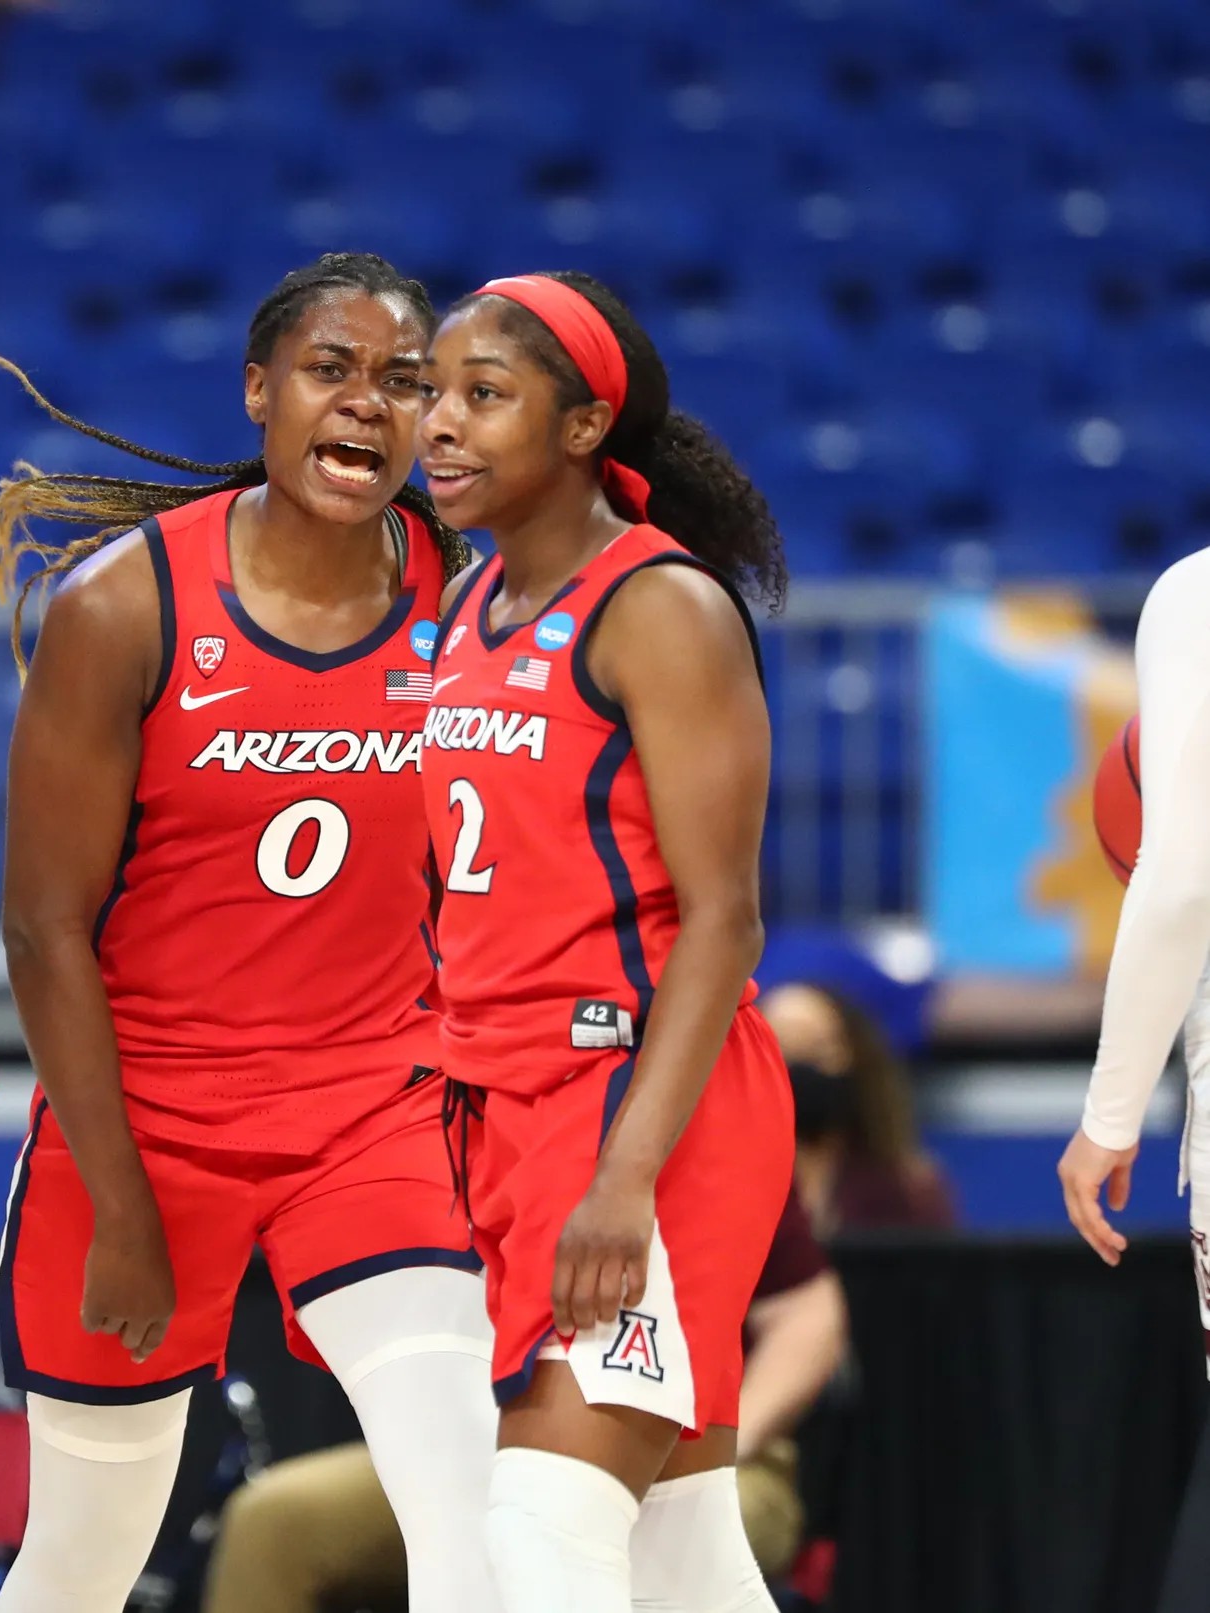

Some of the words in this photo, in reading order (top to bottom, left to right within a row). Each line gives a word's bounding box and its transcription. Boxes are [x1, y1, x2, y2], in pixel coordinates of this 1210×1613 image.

[193, 637, 226, 662] PAC
[198, 653, 216, 669] 12
[414, 637, 435, 650] NCA
[187, 729, 424, 774] ARIZONA
[421, 705, 548, 761] ARIZONA
[254, 796, 351, 899] 0
[445, 777, 498, 894] 2
[581, 1004, 608, 1023] 42
[602, 1309, 665, 1384] A
